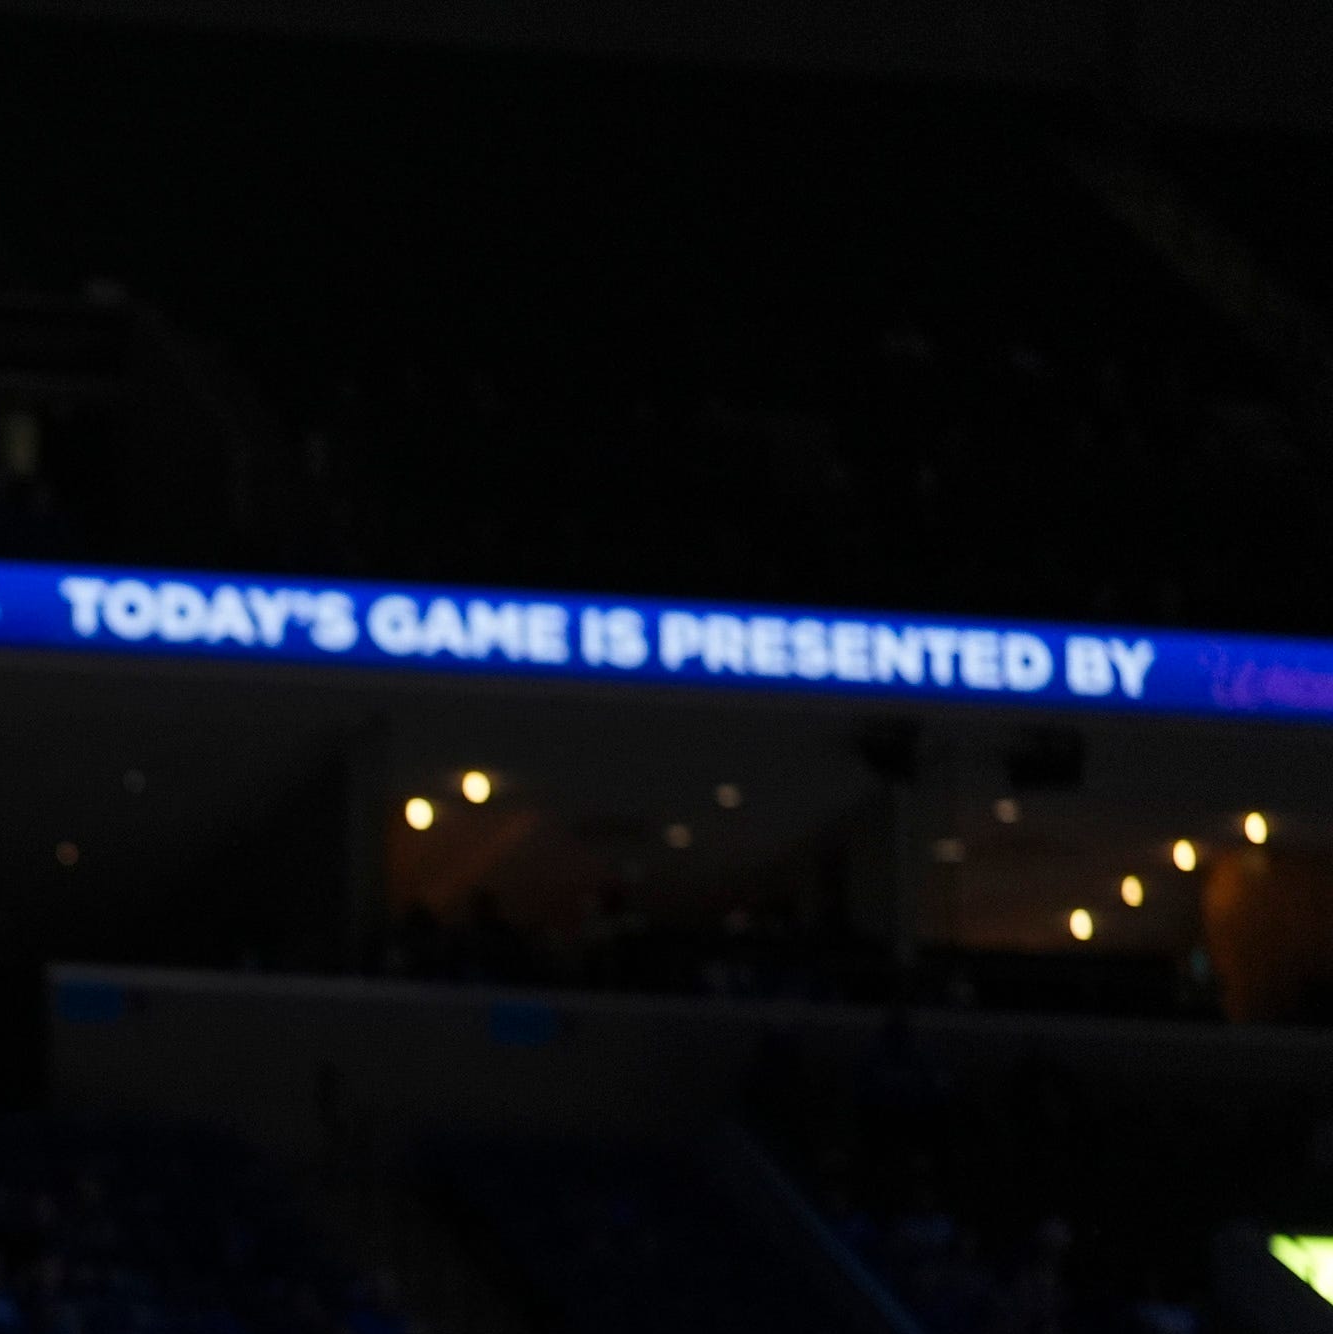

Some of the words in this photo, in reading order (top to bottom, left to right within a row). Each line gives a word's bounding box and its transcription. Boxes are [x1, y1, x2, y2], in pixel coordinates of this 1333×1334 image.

[59, 576, 359, 652] TODAY'S
[367, 594, 570, 665] GAME
[579, 606, 648, 669] IS
[658, 610, 1054, 692] PRESENTED
[1065, 635, 1156, 698] BY
